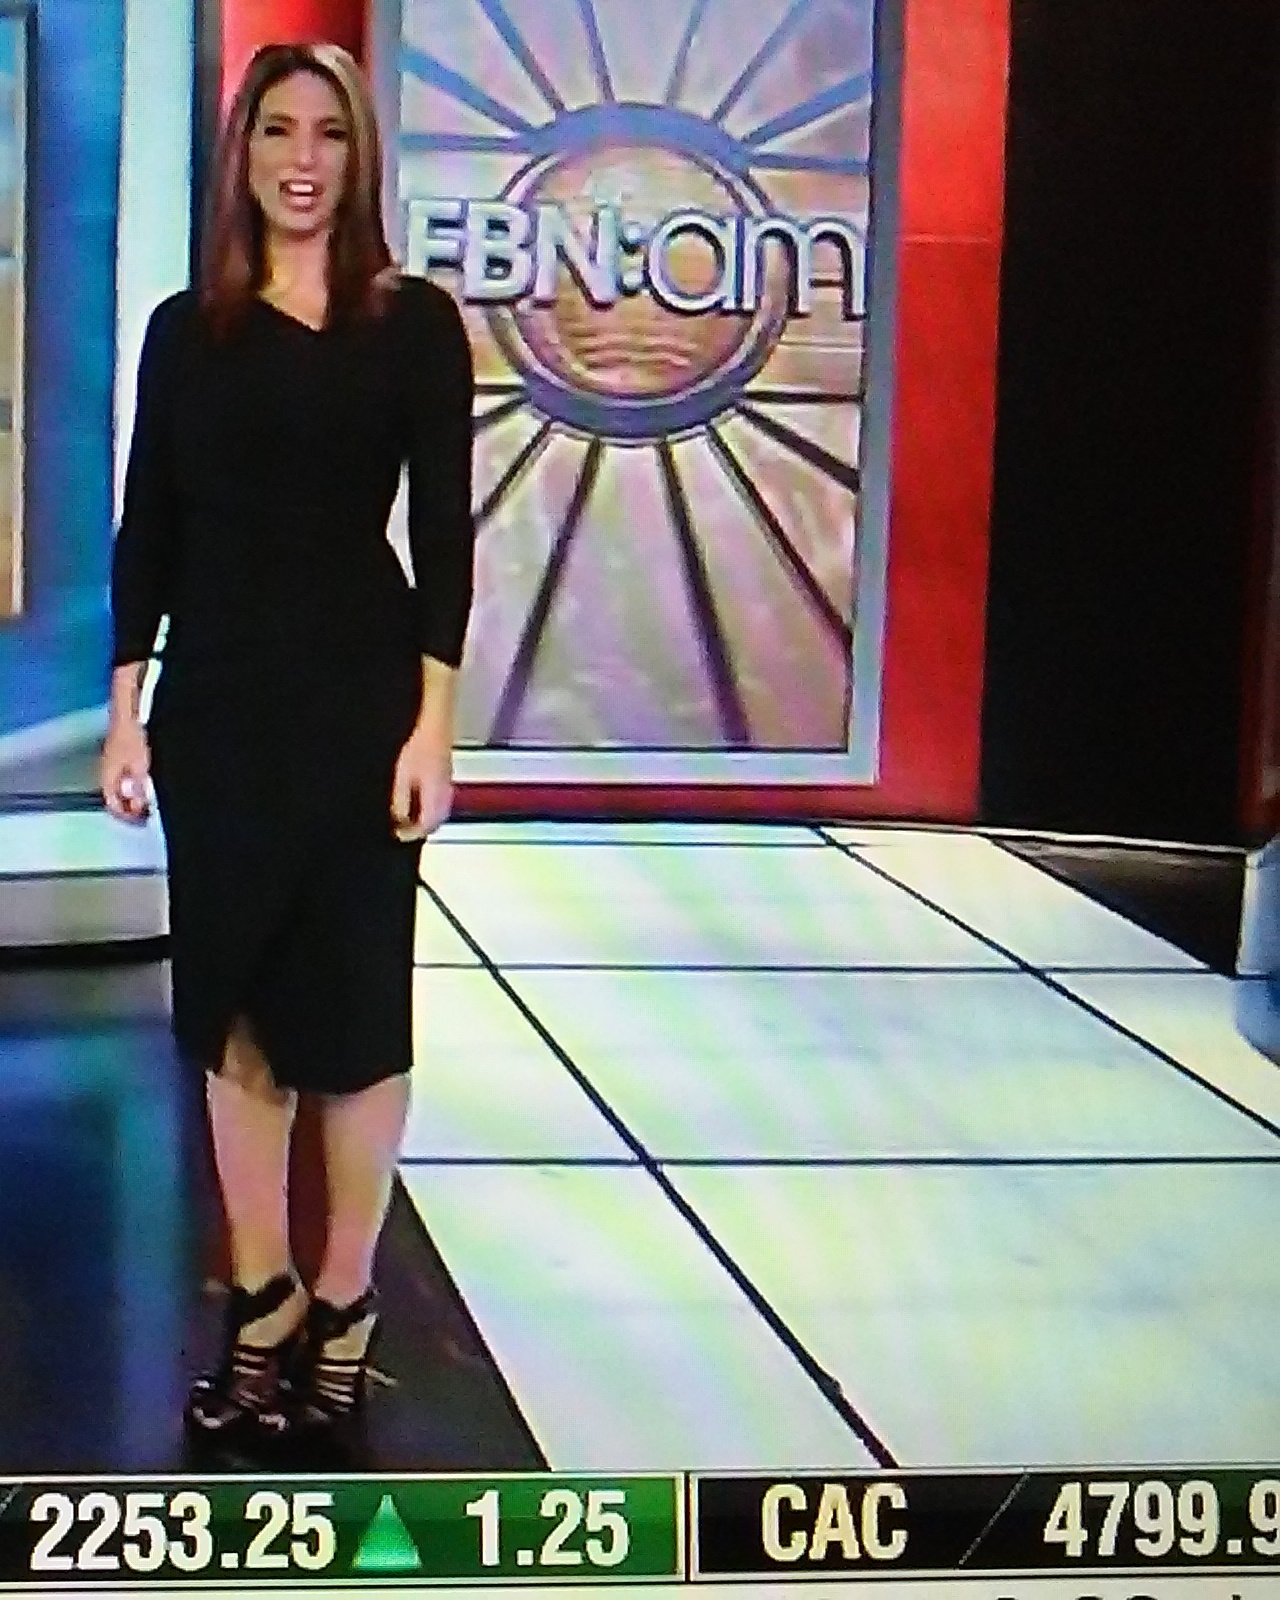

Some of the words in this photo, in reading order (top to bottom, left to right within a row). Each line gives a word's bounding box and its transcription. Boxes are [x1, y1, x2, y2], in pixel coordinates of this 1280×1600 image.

[405, 199, 867, 320] FBN:am
[29, 1491, 335, 1572] 2253.25
[465, 1488, 630, 1567] 1.25
[761, 1484, 908, 1560] CAC
[1043, 1480, 1280, 1557] 4799.9
